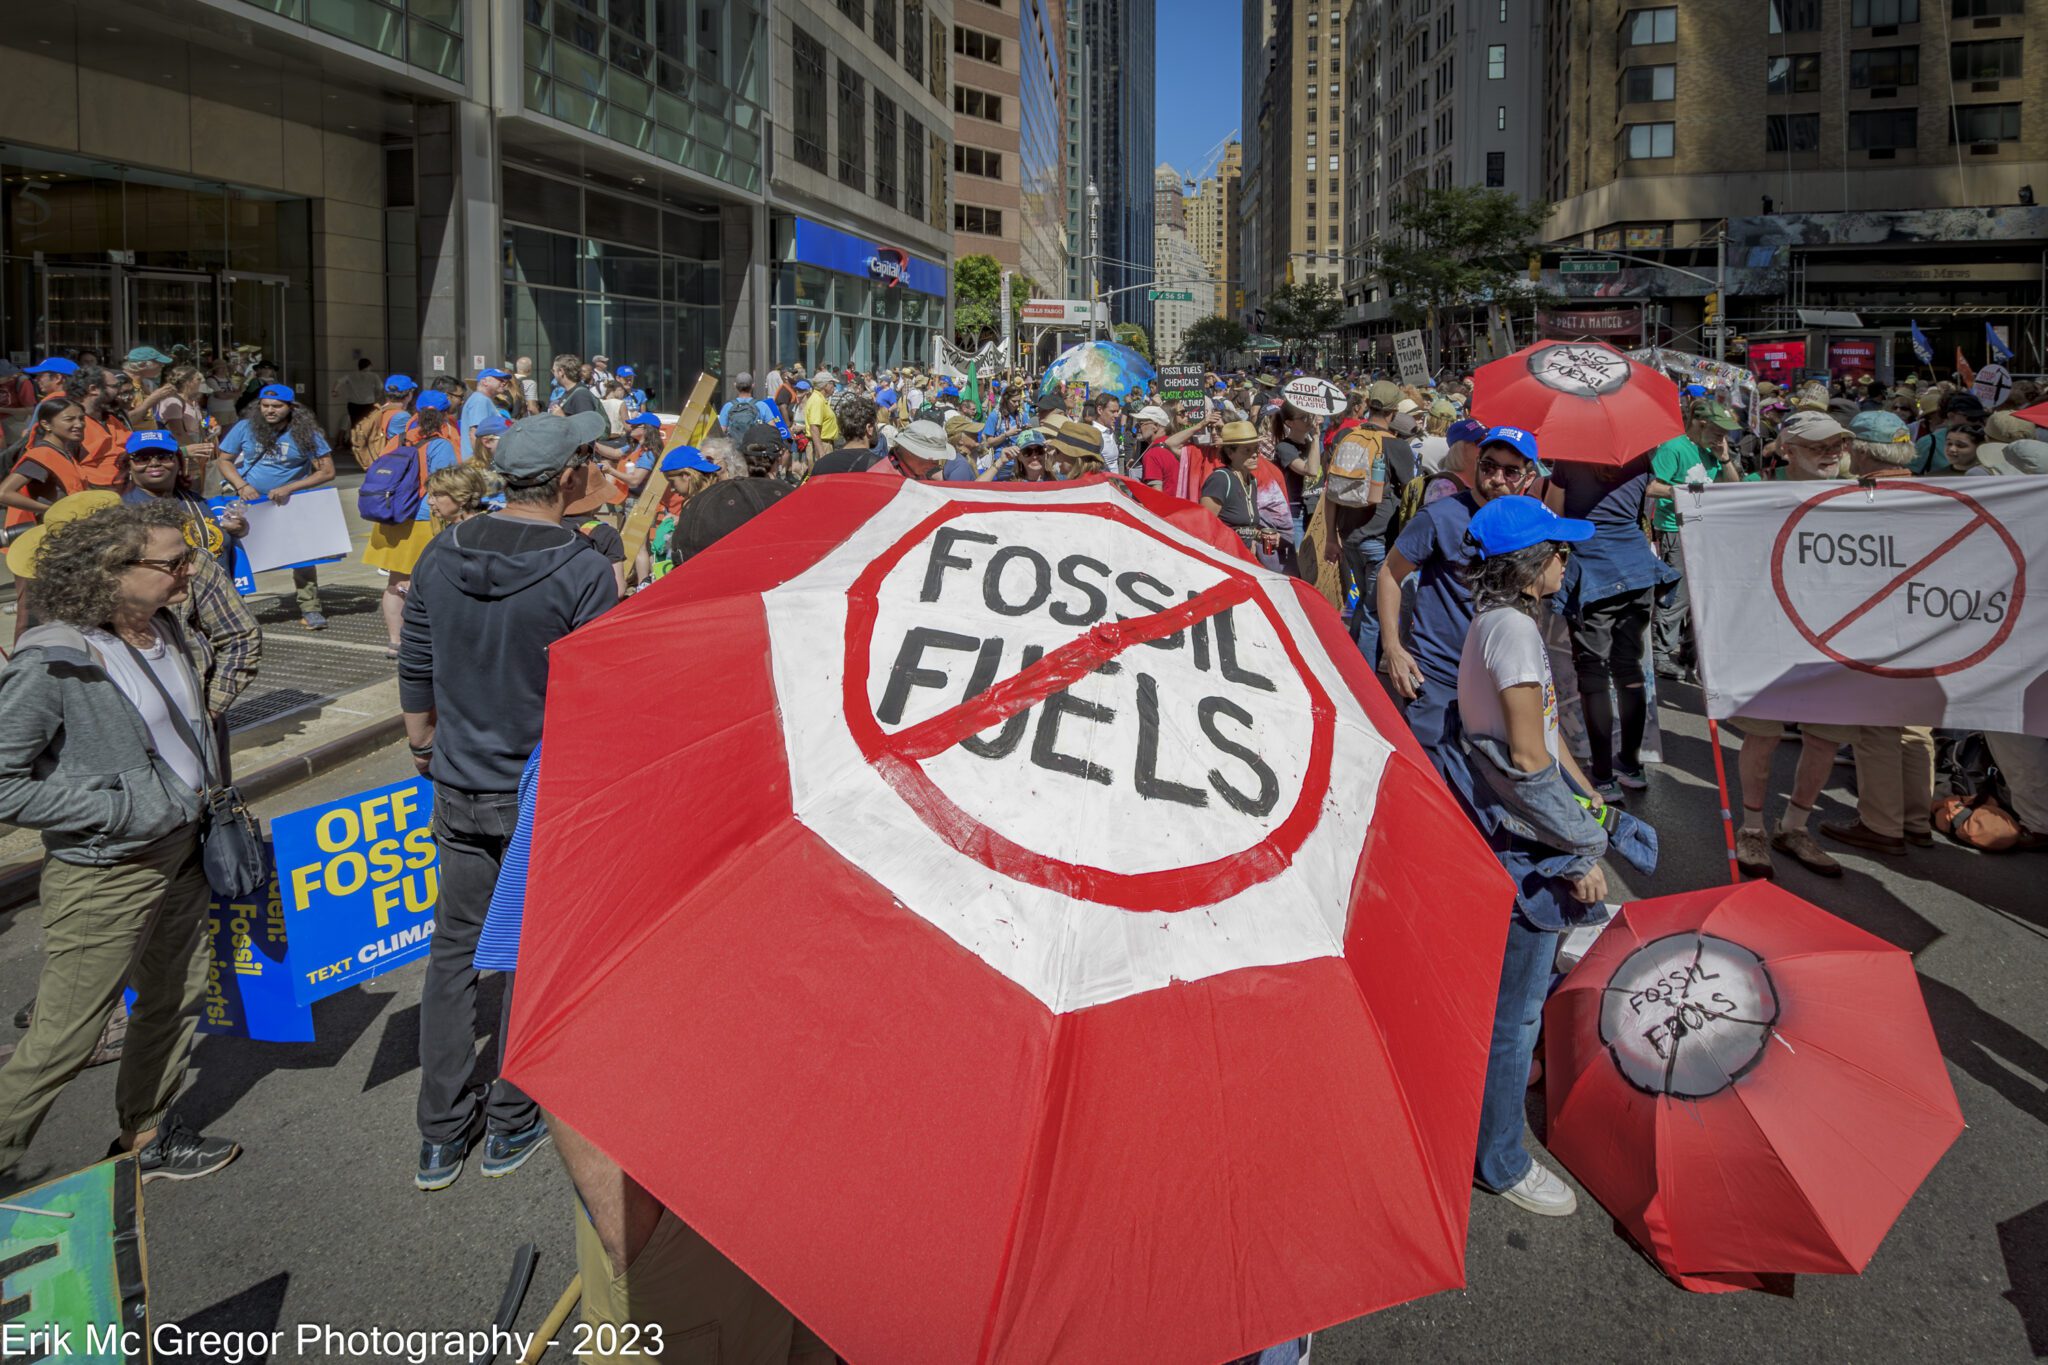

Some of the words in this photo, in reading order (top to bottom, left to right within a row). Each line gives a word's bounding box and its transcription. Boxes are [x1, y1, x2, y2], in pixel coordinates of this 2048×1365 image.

[870, 256, 899, 277] Capital
[1573, 263, 1581, 271] W
[1585, 263, 1594, 271] 56
[1597, 263, 1606, 271] St
[1165, 292, 1175, 300] 56
[1556, 316, 1577, 329] PRET
[1580, 318, 1587, 329] A
[1589, 316, 1623, 329] MANGER
[1396, 336, 1418, 350] BEAT
[1398, 348, 1423, 363] TRUMP
[1161, 367, 1182, 375] FOSSIL
[1183, 365, 1202, 374] FUELS
[1403, 362, 1424, 377] 2024
[1553, 350, 1611, 379] FOSSIL
[1164, 378, 1199, 387] CHEMICALS
[1292, 382, 1318, 393] STOP
[1160, 390, 1182, 399] PLASTIC
[1183, 389, 1203, 398] GRASS
[1288, 393, 1326, 403] FRACKING
[1295, 400, 1326, 410] PLASTIC
[1798, 531, 1907, 568] FOSSIL
[919, 526, 1278, 693] FOSSIL
[1907, 582, 2007, 624] FOOLS
[876, 626, 1280, 818] FUELS
[315, 786, 418, 853] OFF
[372, 865, 441, 928] FU
[230, 903, 263, 976] Fossil
[306, 957, 353, 985] TEXT
[357, 919, 436, 964] CLIMA
[1629, 963, 1720, 1016] FOSSIL
